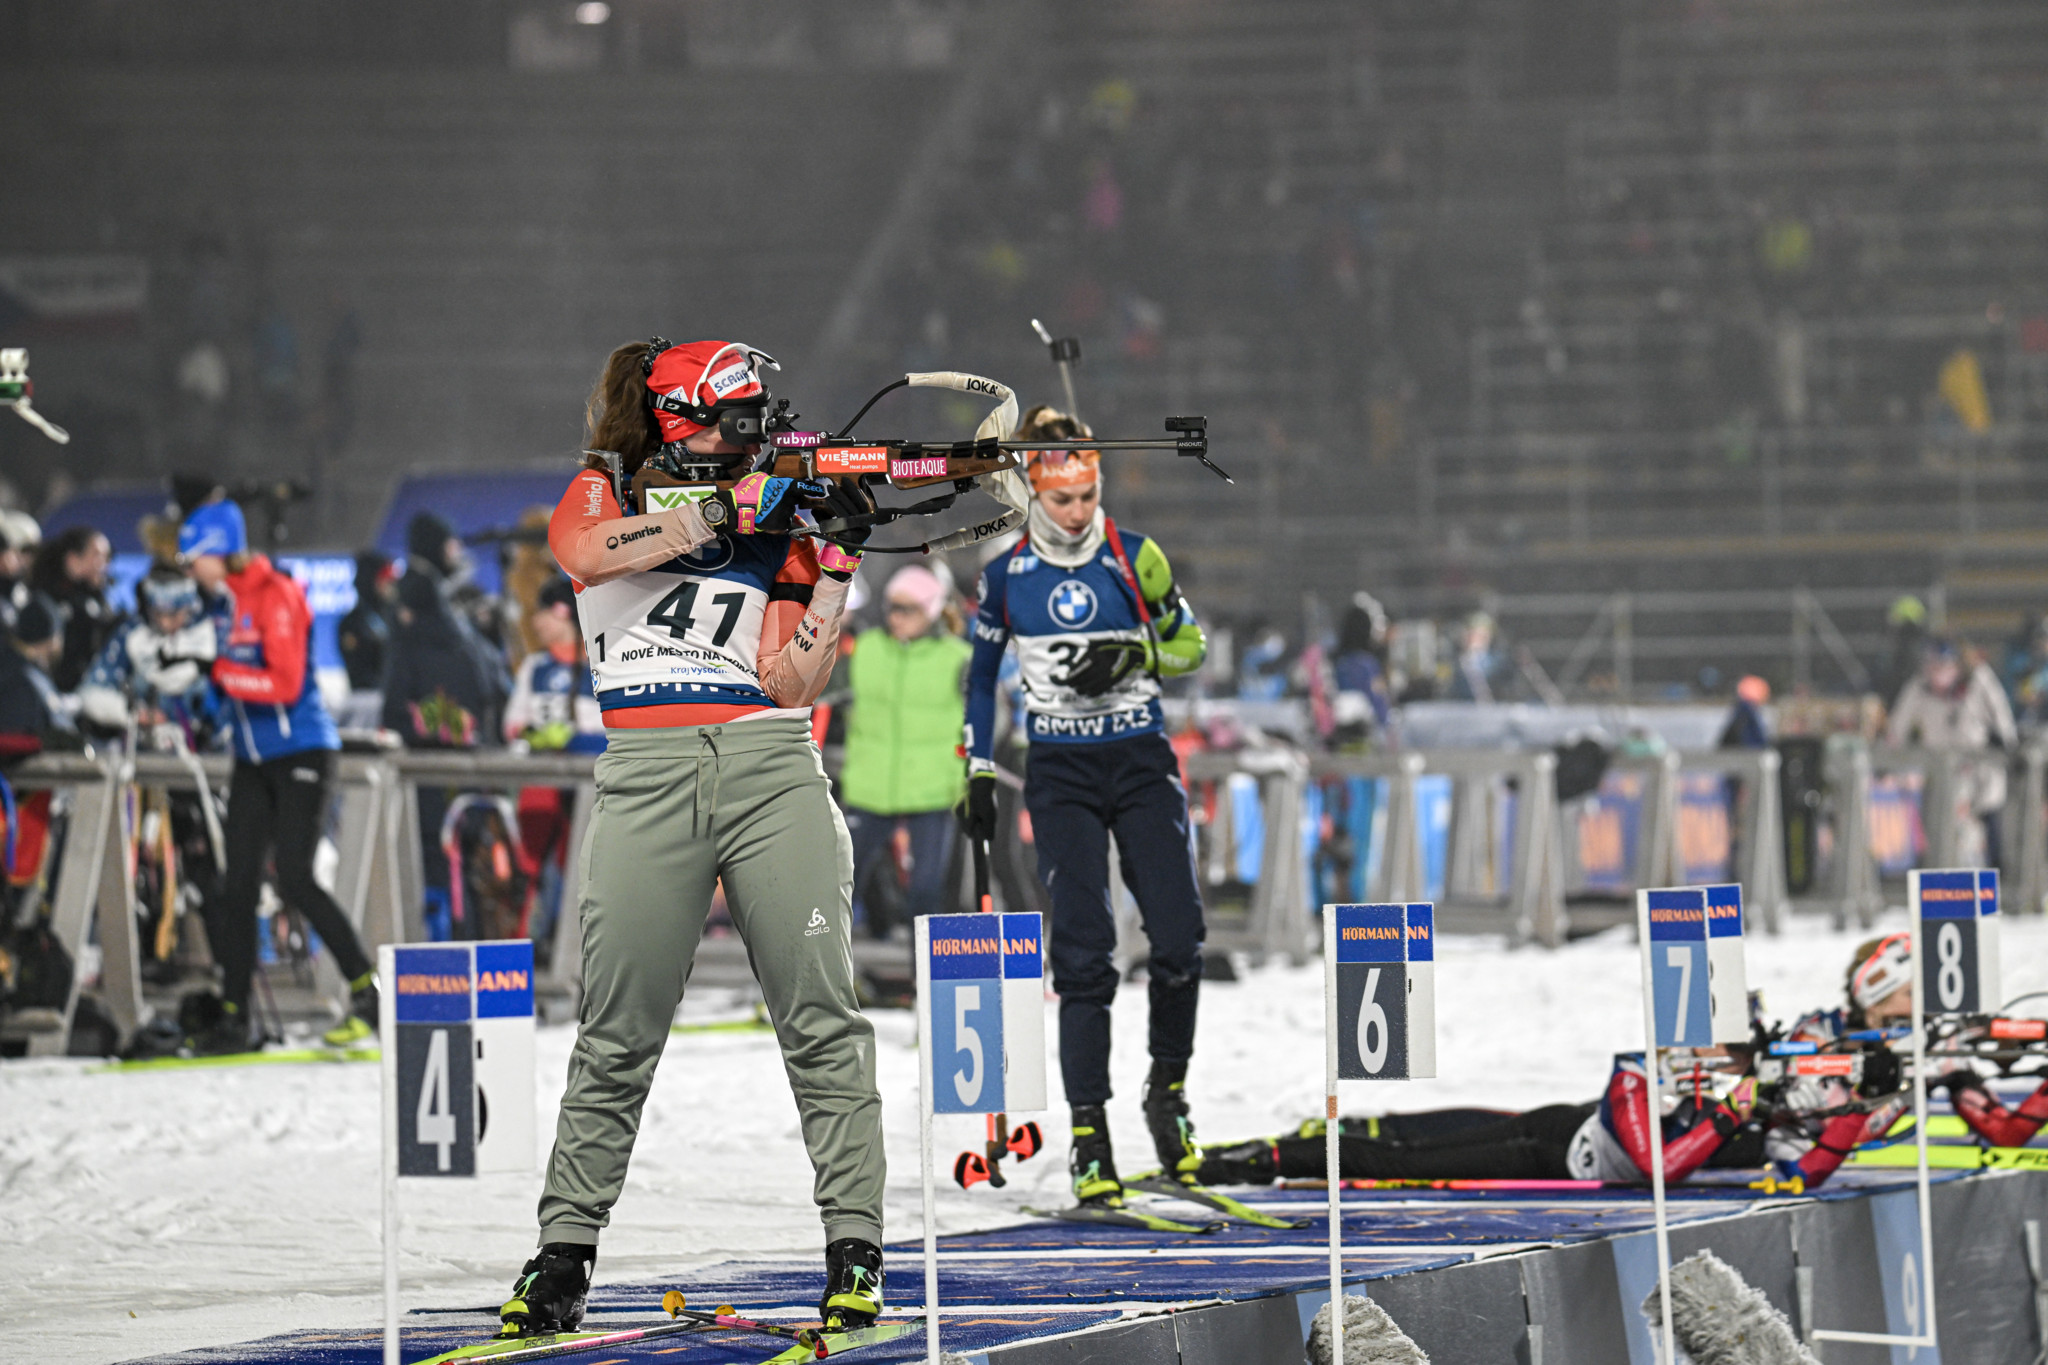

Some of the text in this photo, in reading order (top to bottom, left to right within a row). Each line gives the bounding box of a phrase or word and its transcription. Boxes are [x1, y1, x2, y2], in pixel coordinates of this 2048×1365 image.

[966, 378, 998, 397] JOKA
[818, 450, 886, 466] VIESSMANN
[892, 459, 946, 476] BIOTEAQUE
[620, 525, 662, 545] Sunrise
[973, 516, 1008, 541] JOKA
[646, 581, 747, 648] 41
[621, 644, 654, 662] NOVÉ
[702, 650, 721, 661] NA
[670, 666, 690, 676] Kraj
[804, 926, 830, 937] odlo
[1341, 926, 1400, 940] HÖRMANN
[932, 937, 998, 956] HÖRMANN
[1936, 921, 1965, 1011] 8
[1666, 946, 1692, 1043] 7
[1356, 967, 1388, 1074] 6
[953, 985, 984, 1107] 5
[416, 1028, 457, 1172] 4
